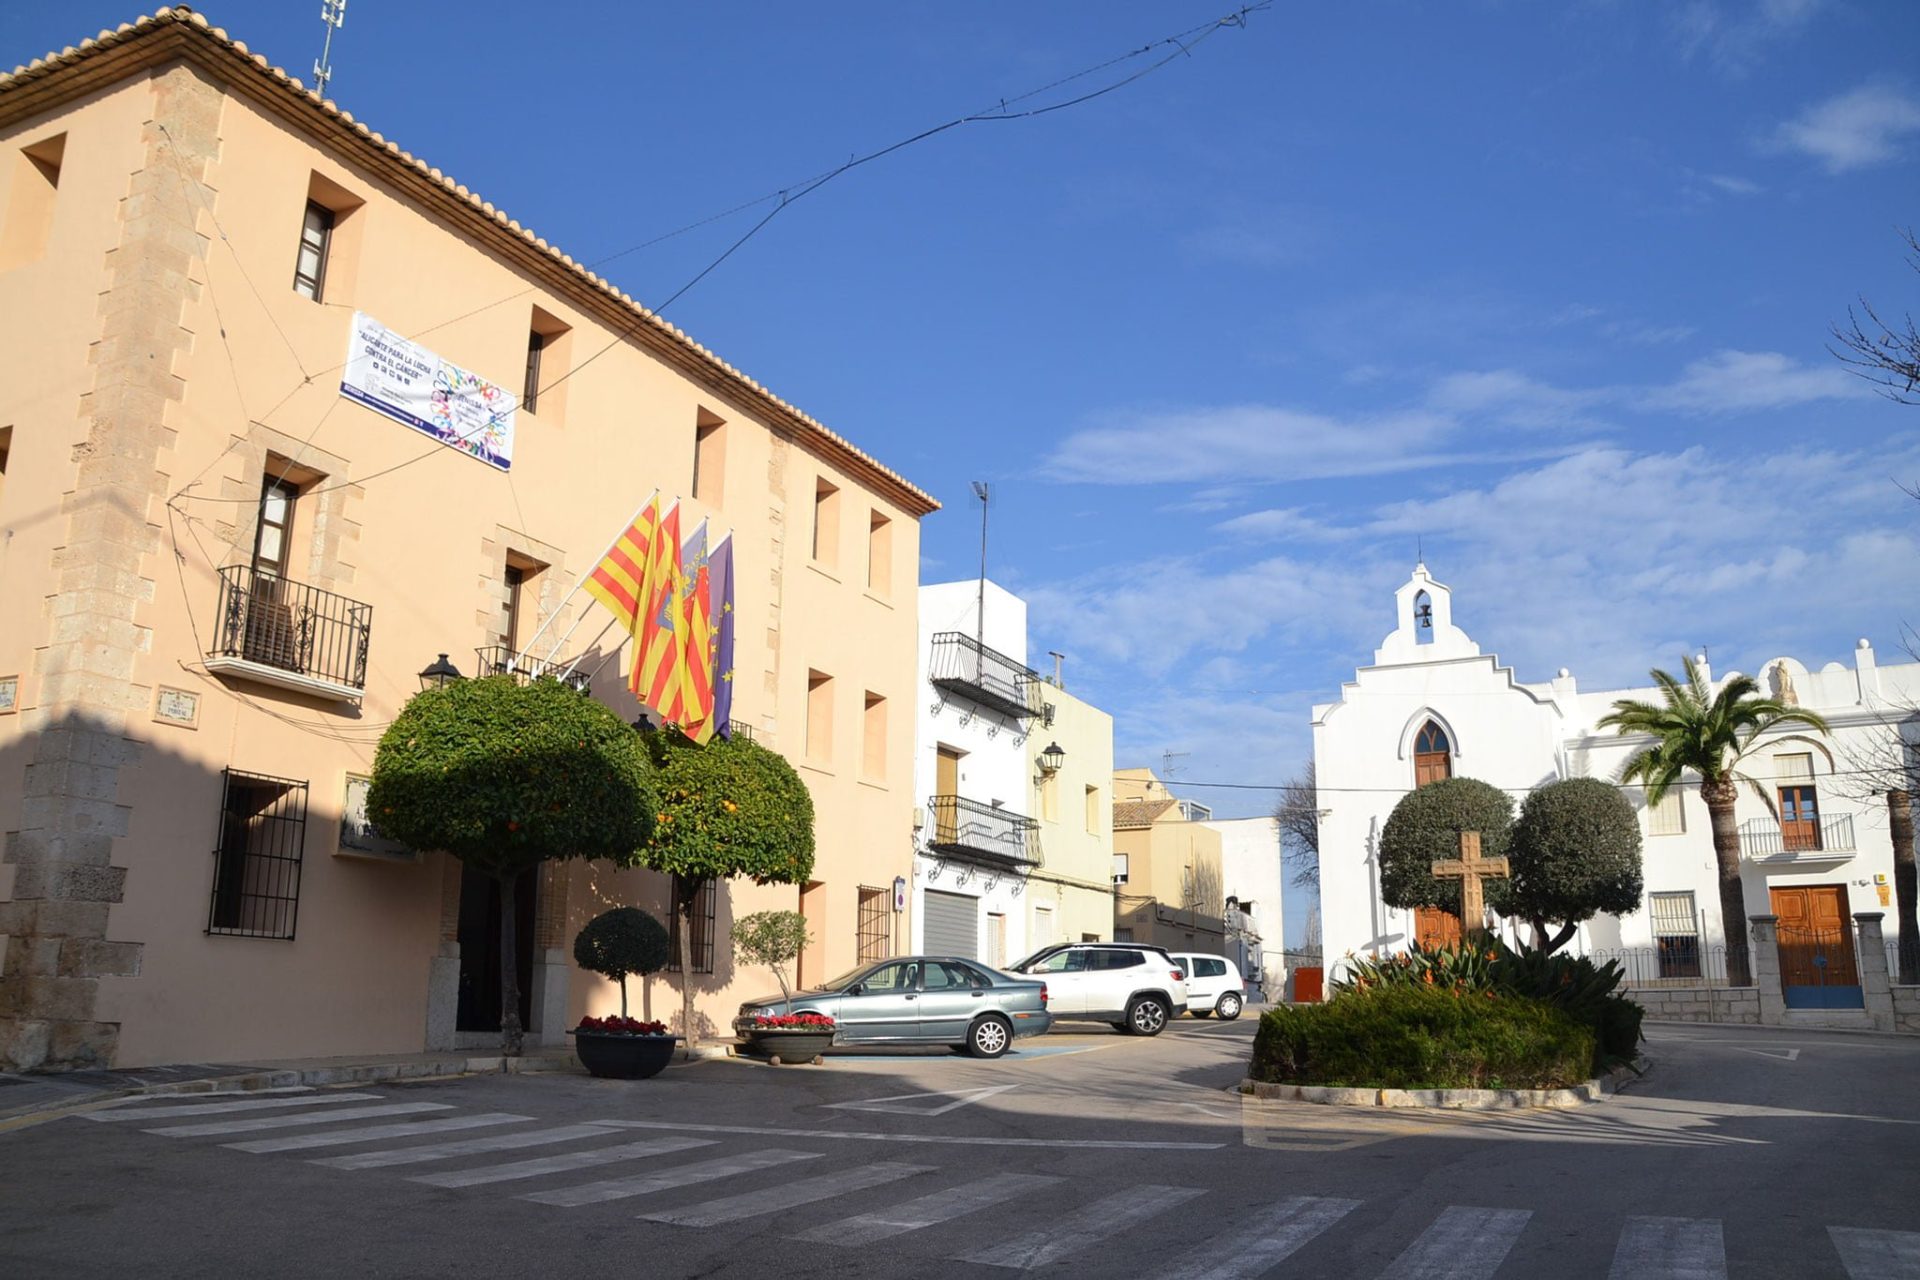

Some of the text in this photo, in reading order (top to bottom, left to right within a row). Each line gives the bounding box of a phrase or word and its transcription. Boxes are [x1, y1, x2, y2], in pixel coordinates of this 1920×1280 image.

[365, 345, 387, 363] CONTRA
[387, 358, 394, 367] EL
[388, 347, 403, 360] PARA
[405, 356, 412, 365] LA
[413, 360, 431, 374] LUCHA
